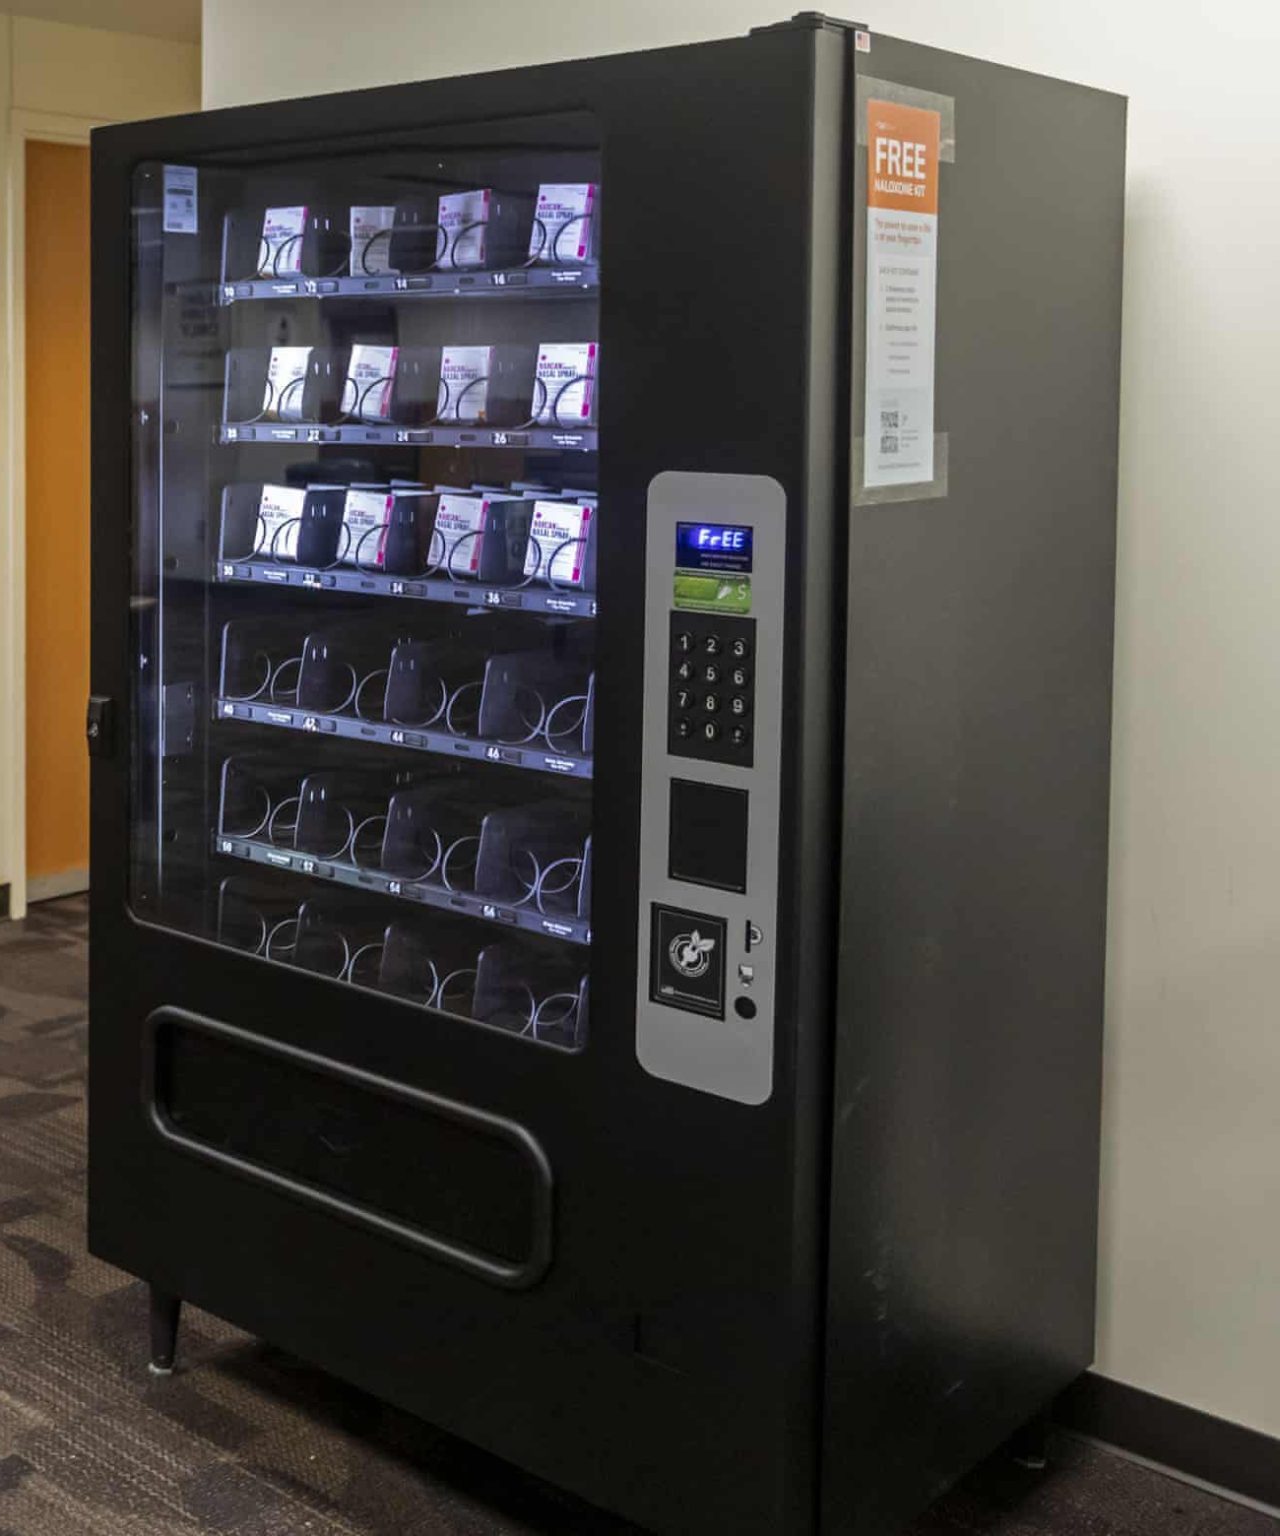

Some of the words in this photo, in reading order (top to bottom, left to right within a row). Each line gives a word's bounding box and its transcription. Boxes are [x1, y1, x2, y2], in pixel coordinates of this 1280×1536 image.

[875, 136, 927, 180] FREE
[680, 635, 688, 651] 1
[706, 638, 716, 653] 2
[733, 641, 744, 656] 3
[679, 663, 688, 679] 4
[706, 666, 715, 681] 5
[733, 670, 744, 685] 6
[679, 692, 687, 708] 7
[706, 695, 715, 710] 8
[732, 699, 743, 713] 9
[705, 723, 714, 738] 0
